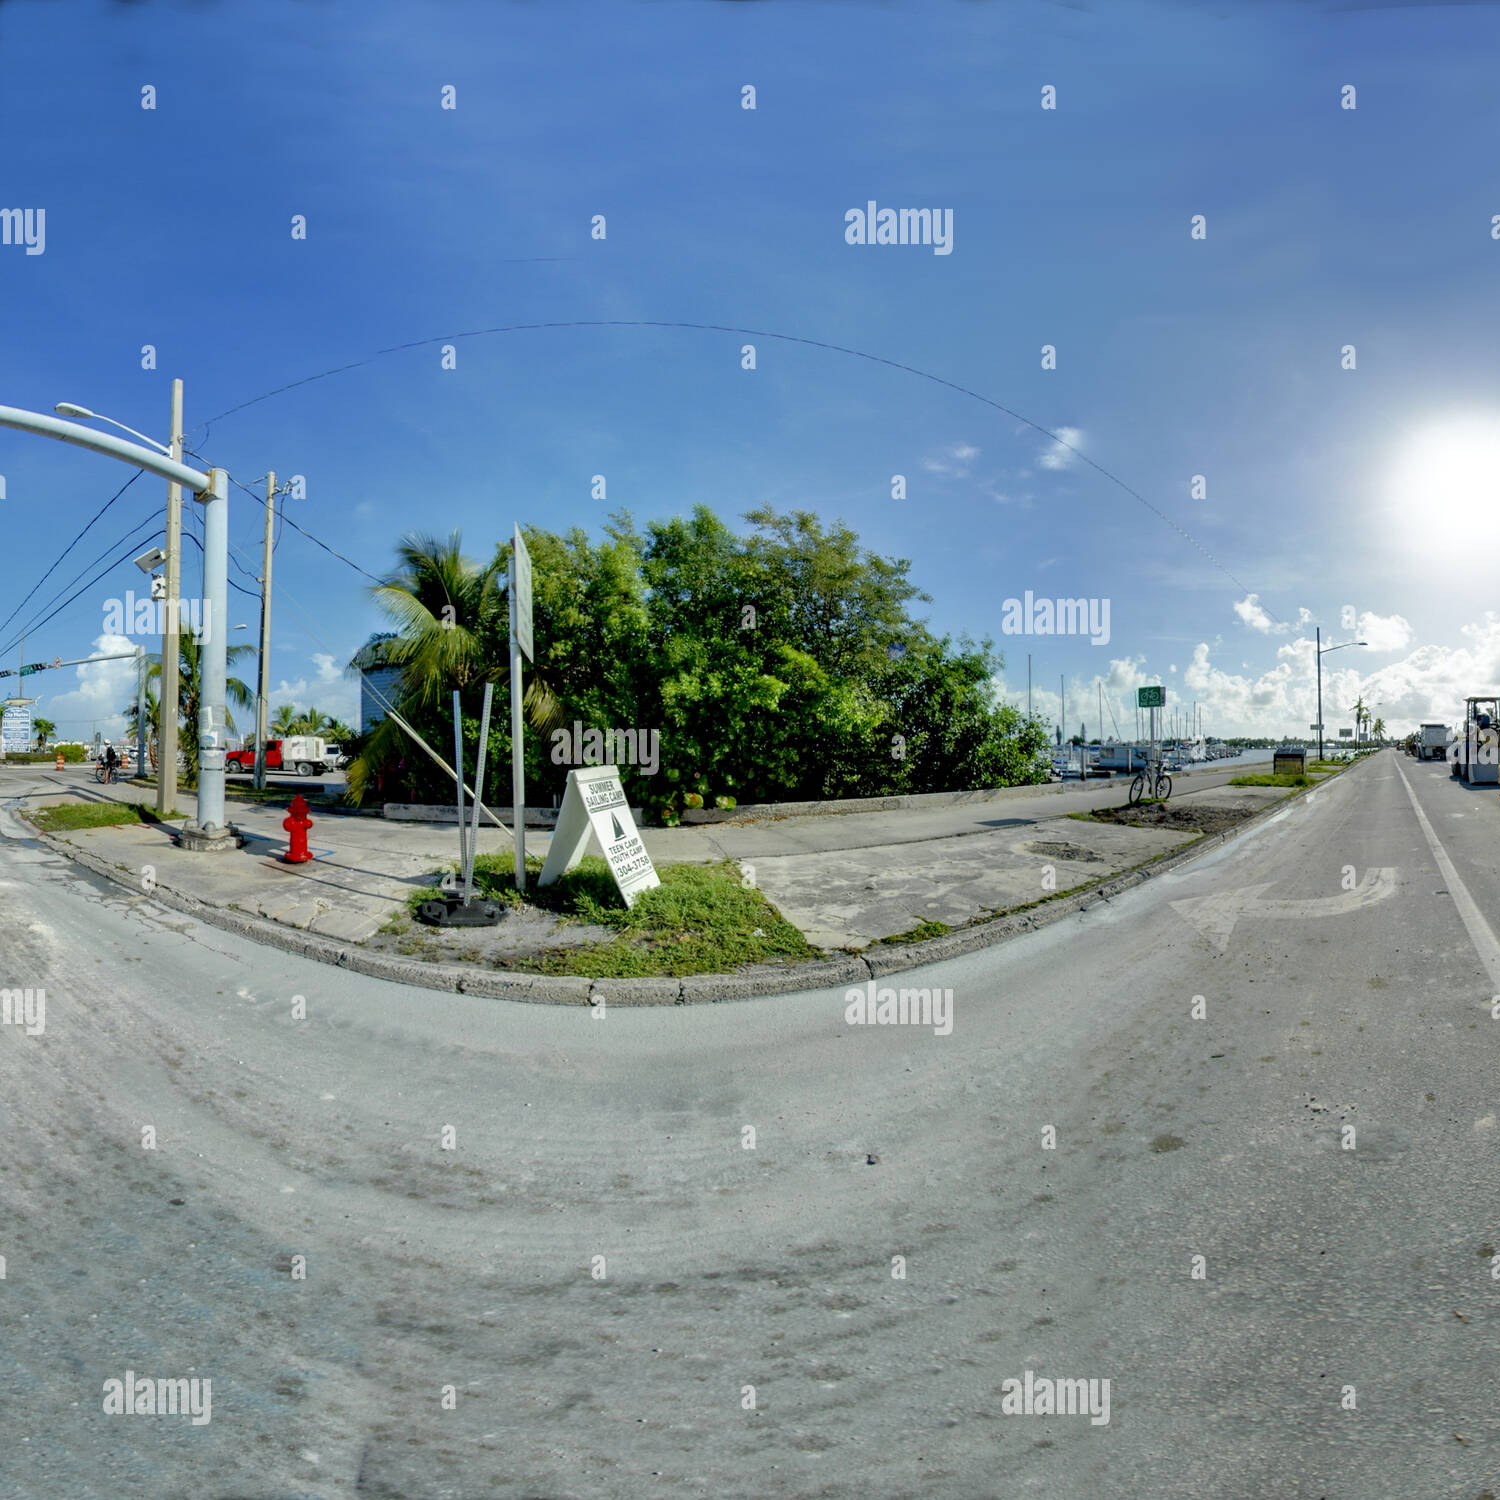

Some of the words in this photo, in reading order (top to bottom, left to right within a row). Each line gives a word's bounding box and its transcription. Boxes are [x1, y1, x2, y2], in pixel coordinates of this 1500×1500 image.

[588, 780, 615, 795] SUMMER
[585, 793, 609, 807] SAILING
[608, 790, 624, 803] CAMP
[608, 844, 624, 855] TEEN
[624, 837, 639, 849] CAMP
[611, 851, 630, 865] YOUTH
[629, 844, 644, 857] CAMP
